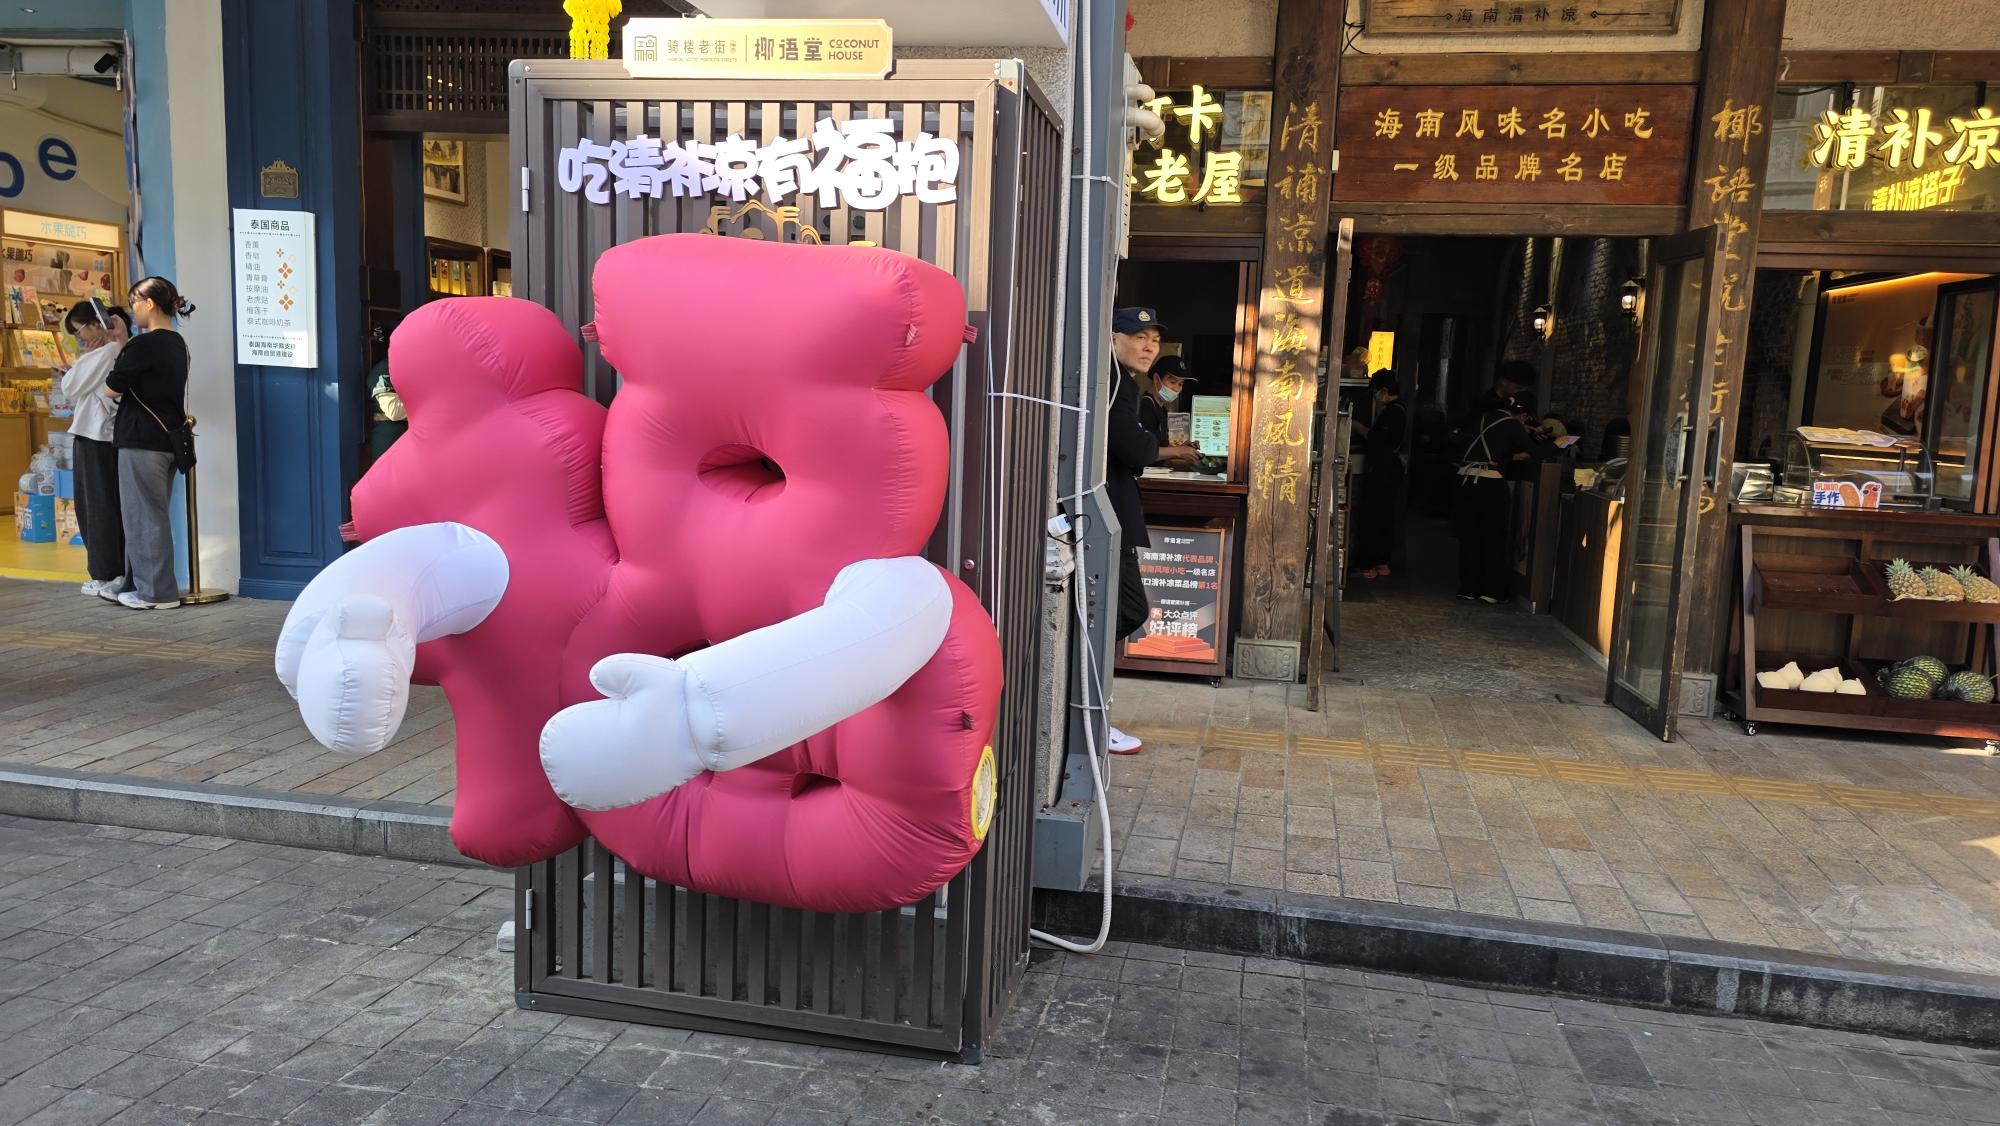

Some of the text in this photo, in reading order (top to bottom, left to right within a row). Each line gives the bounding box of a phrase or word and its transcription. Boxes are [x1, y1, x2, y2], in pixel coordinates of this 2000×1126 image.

[1458, 7, 1578, 23] 海南清补凉
[667, 39, 726, 54] 骑楼老街
[754, 37, 823, 61] 椰语堂
[828, 39, 880, 50] COCONUT
[828, 51, 864, 61] HOUSE
[1143, 85, 1223, 143] 卡
[1374, 106, 1654, 140] 海南风味名小吃
[1813, 107, 2000, 168] 清补凉
[1393, 153, 1627, 182] 一级品牌名店
[1131, 148, 1243, 203] 老屋
[250, 219, 290, 231] 泰国商品
[246, 284, 269, 293] 按摩油
[247, 317, 291, 326] 泰式咖啡奶茶
[1814, 490, 1839, 503] 手作
[1141, 577, 1218, 590] 口清补凉菜品榜第1名
[1163, 609, 1199, 620] 大众点评
[1149, 620, 1199, 638] 好评榜
